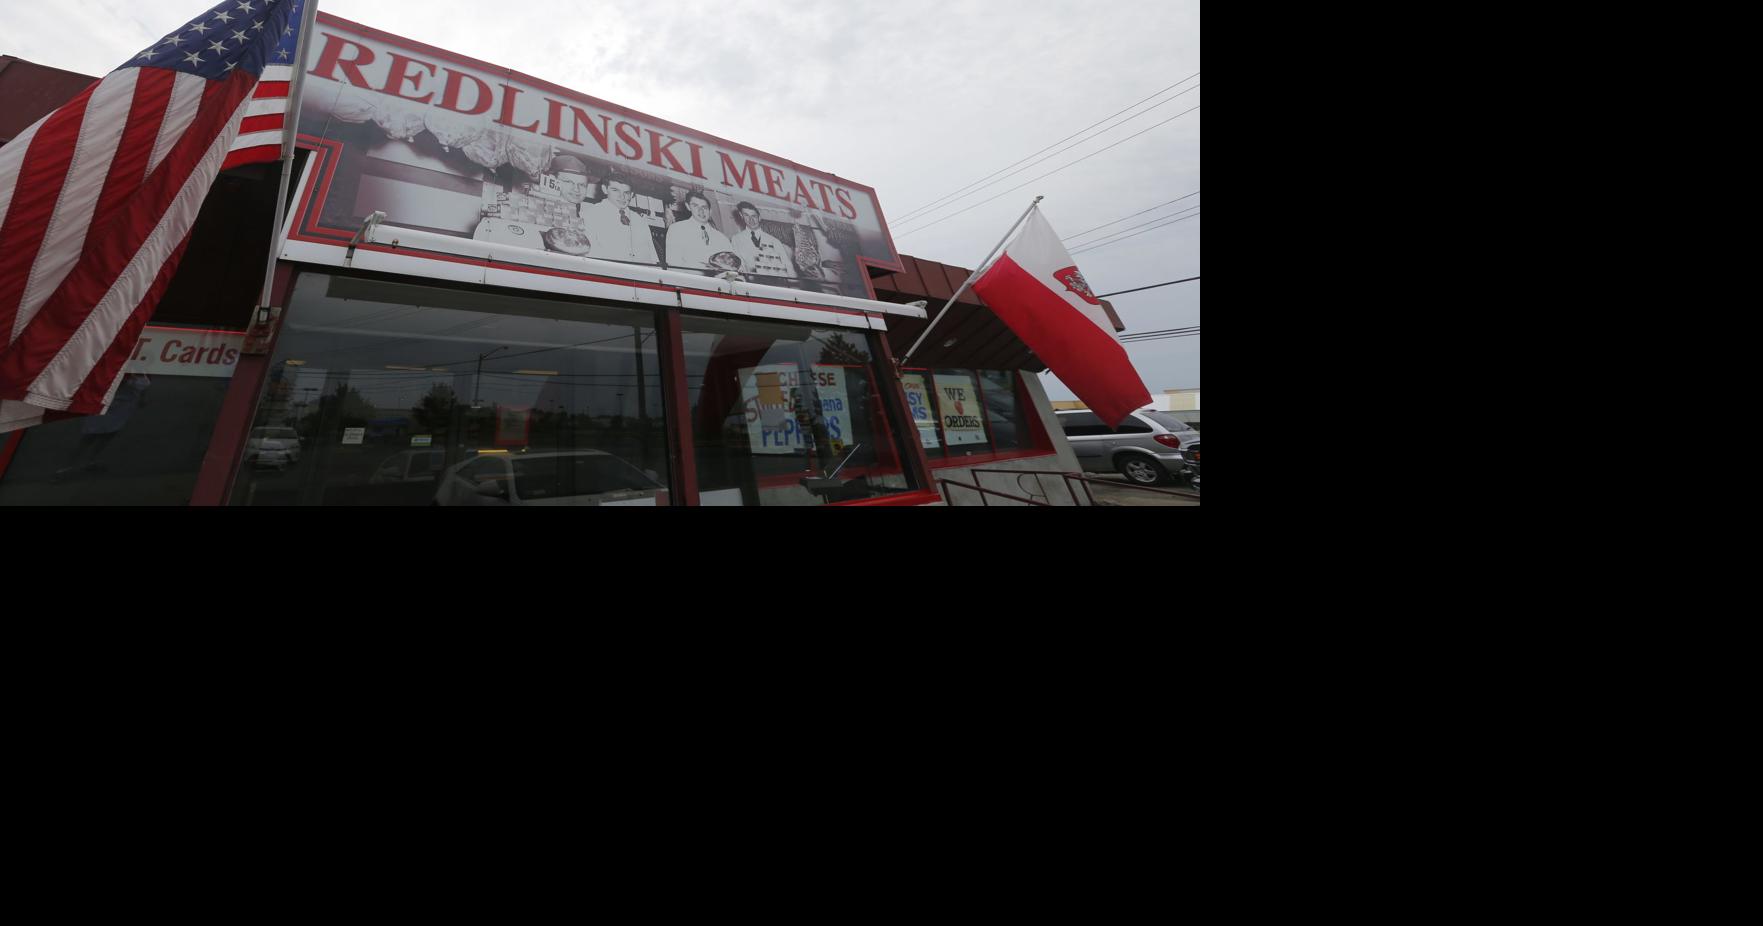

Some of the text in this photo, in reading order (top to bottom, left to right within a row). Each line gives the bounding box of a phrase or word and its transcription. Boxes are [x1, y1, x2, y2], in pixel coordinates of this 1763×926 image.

[307, 31, 858, 221] REDLINSKI MEATS
[160, 339, 238, 365] Cards
[778, 371, 836, 387] CHESE
[943, 387, 967, 401] WE
[944, 415, 981, 428] ORDERS
